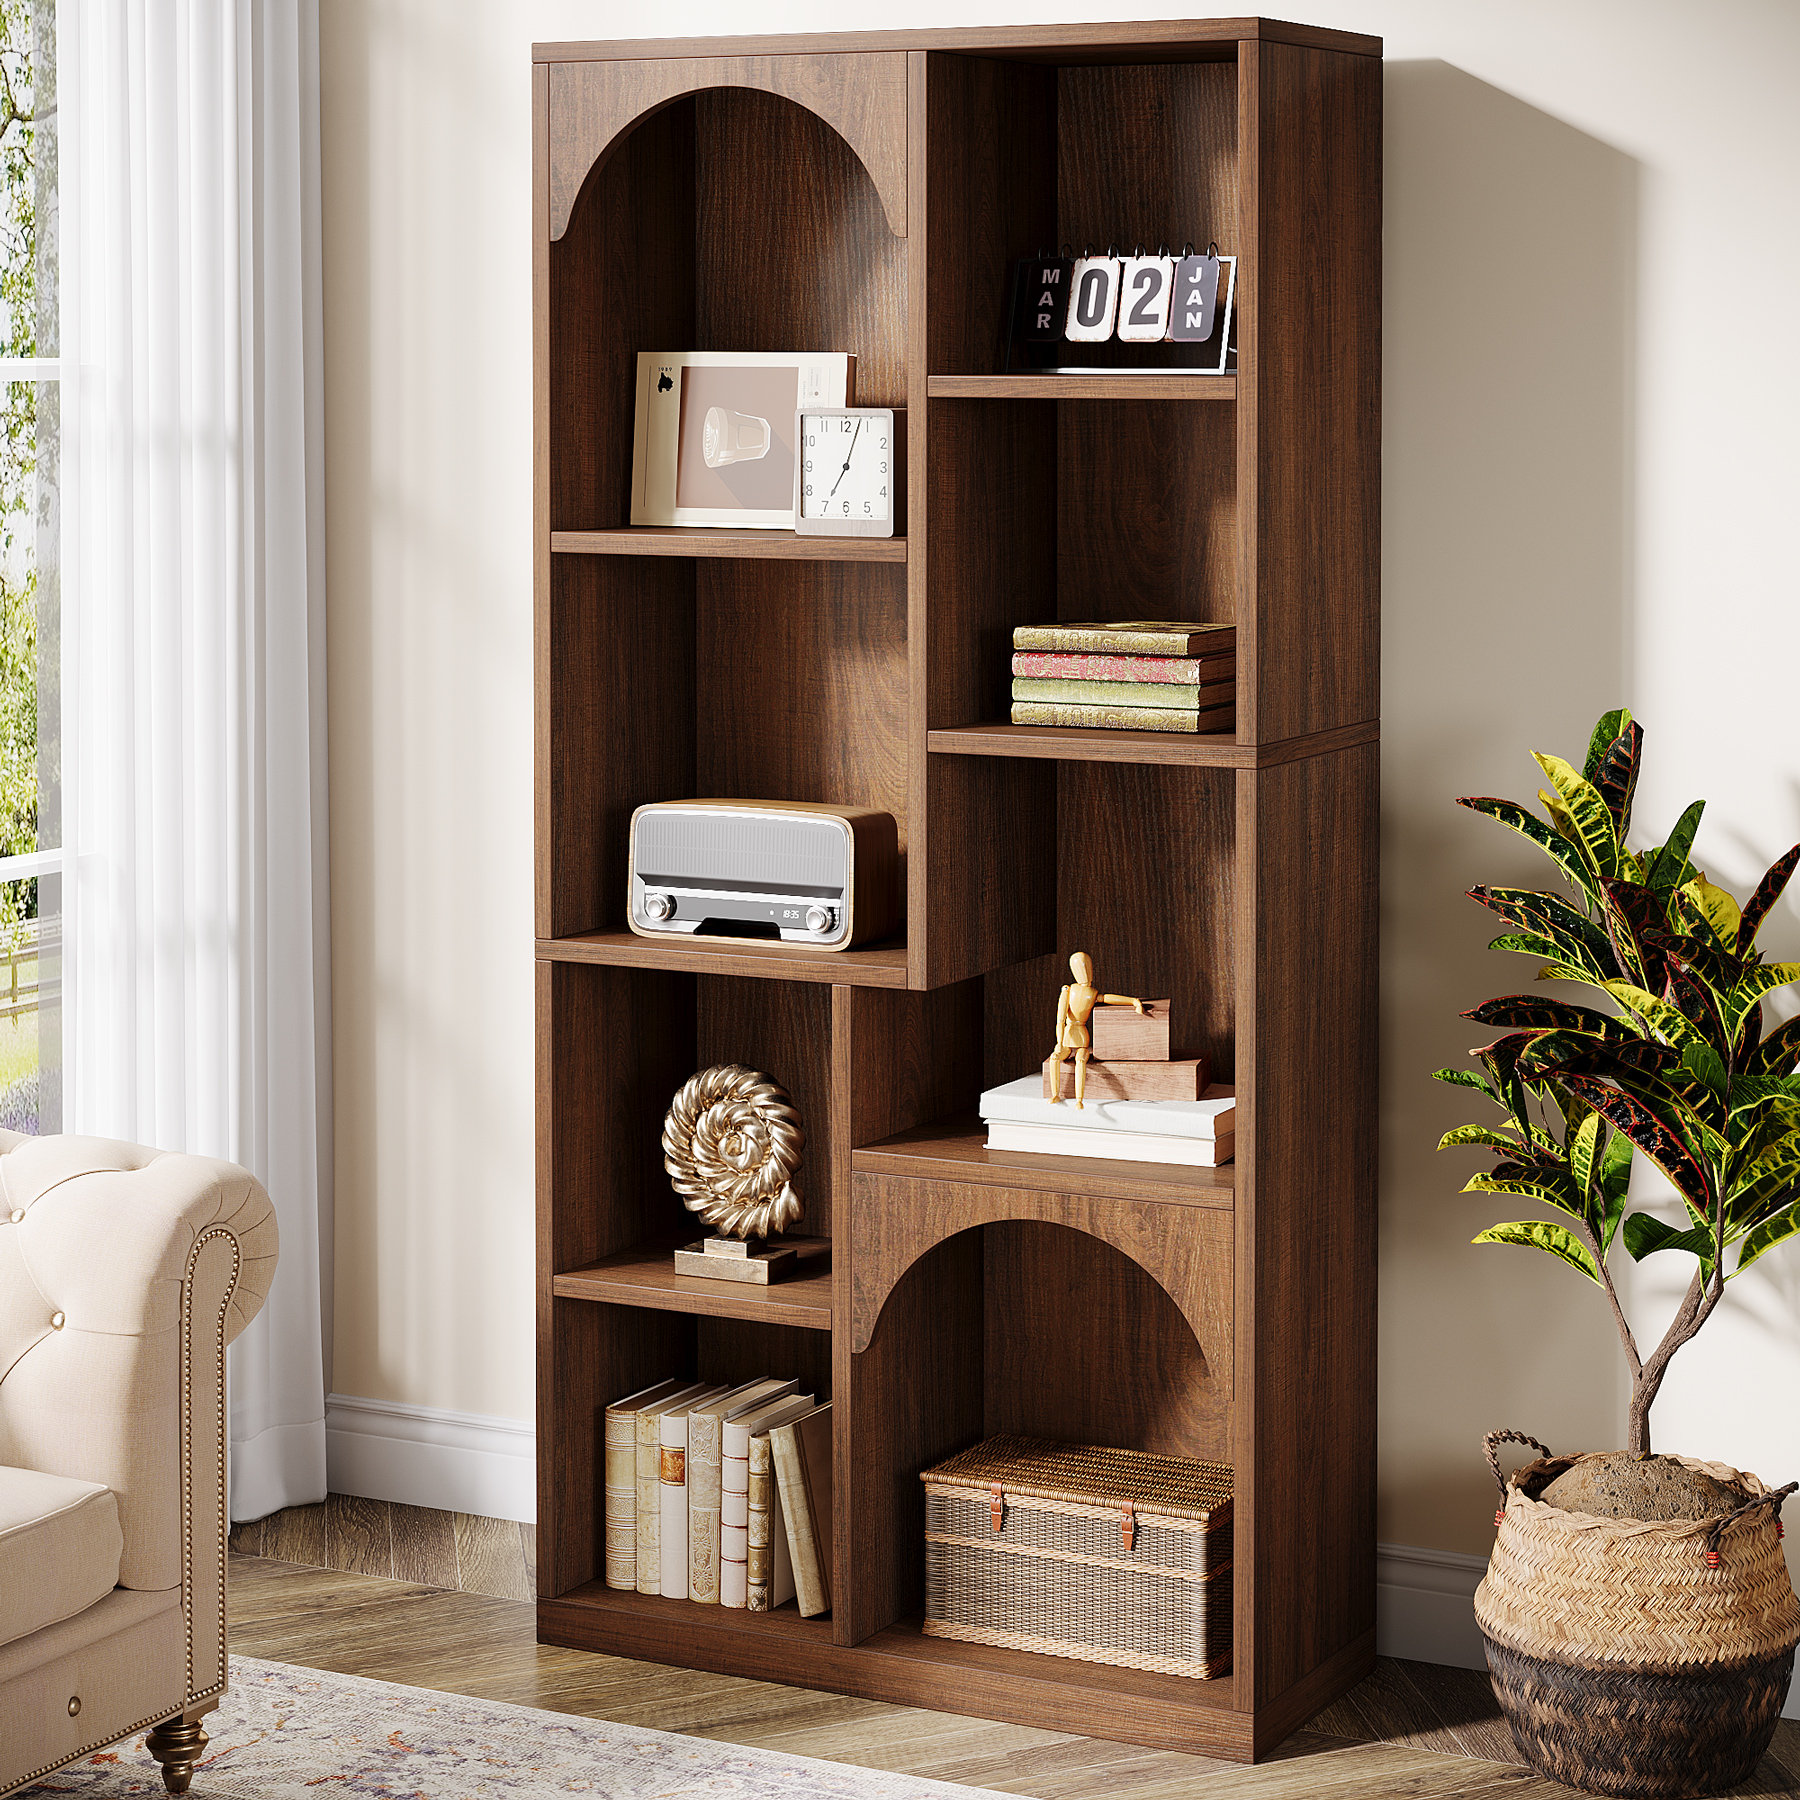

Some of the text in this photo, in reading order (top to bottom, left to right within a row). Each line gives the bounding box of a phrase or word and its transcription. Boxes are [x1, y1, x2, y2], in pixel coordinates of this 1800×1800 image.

[1036, 268, 1060, 329] MAR
[1185, 266, 1204, 329] JAN
[820, 420, 828, 433] 11
[840, 420, 852, 433] 12
[805, 435, 816, 447] 10
[879, 437, 888, 450] 2
[805, 460, 813, 473] 9
[879, 461, 888, 474] 3
[805, 484, 813, 497] 8
[879, 485, 888, 498] 4
[821, 500, 829, 513] 7
[842, 500, 850, 513] 6
[863, 501, 871, 514] 5
